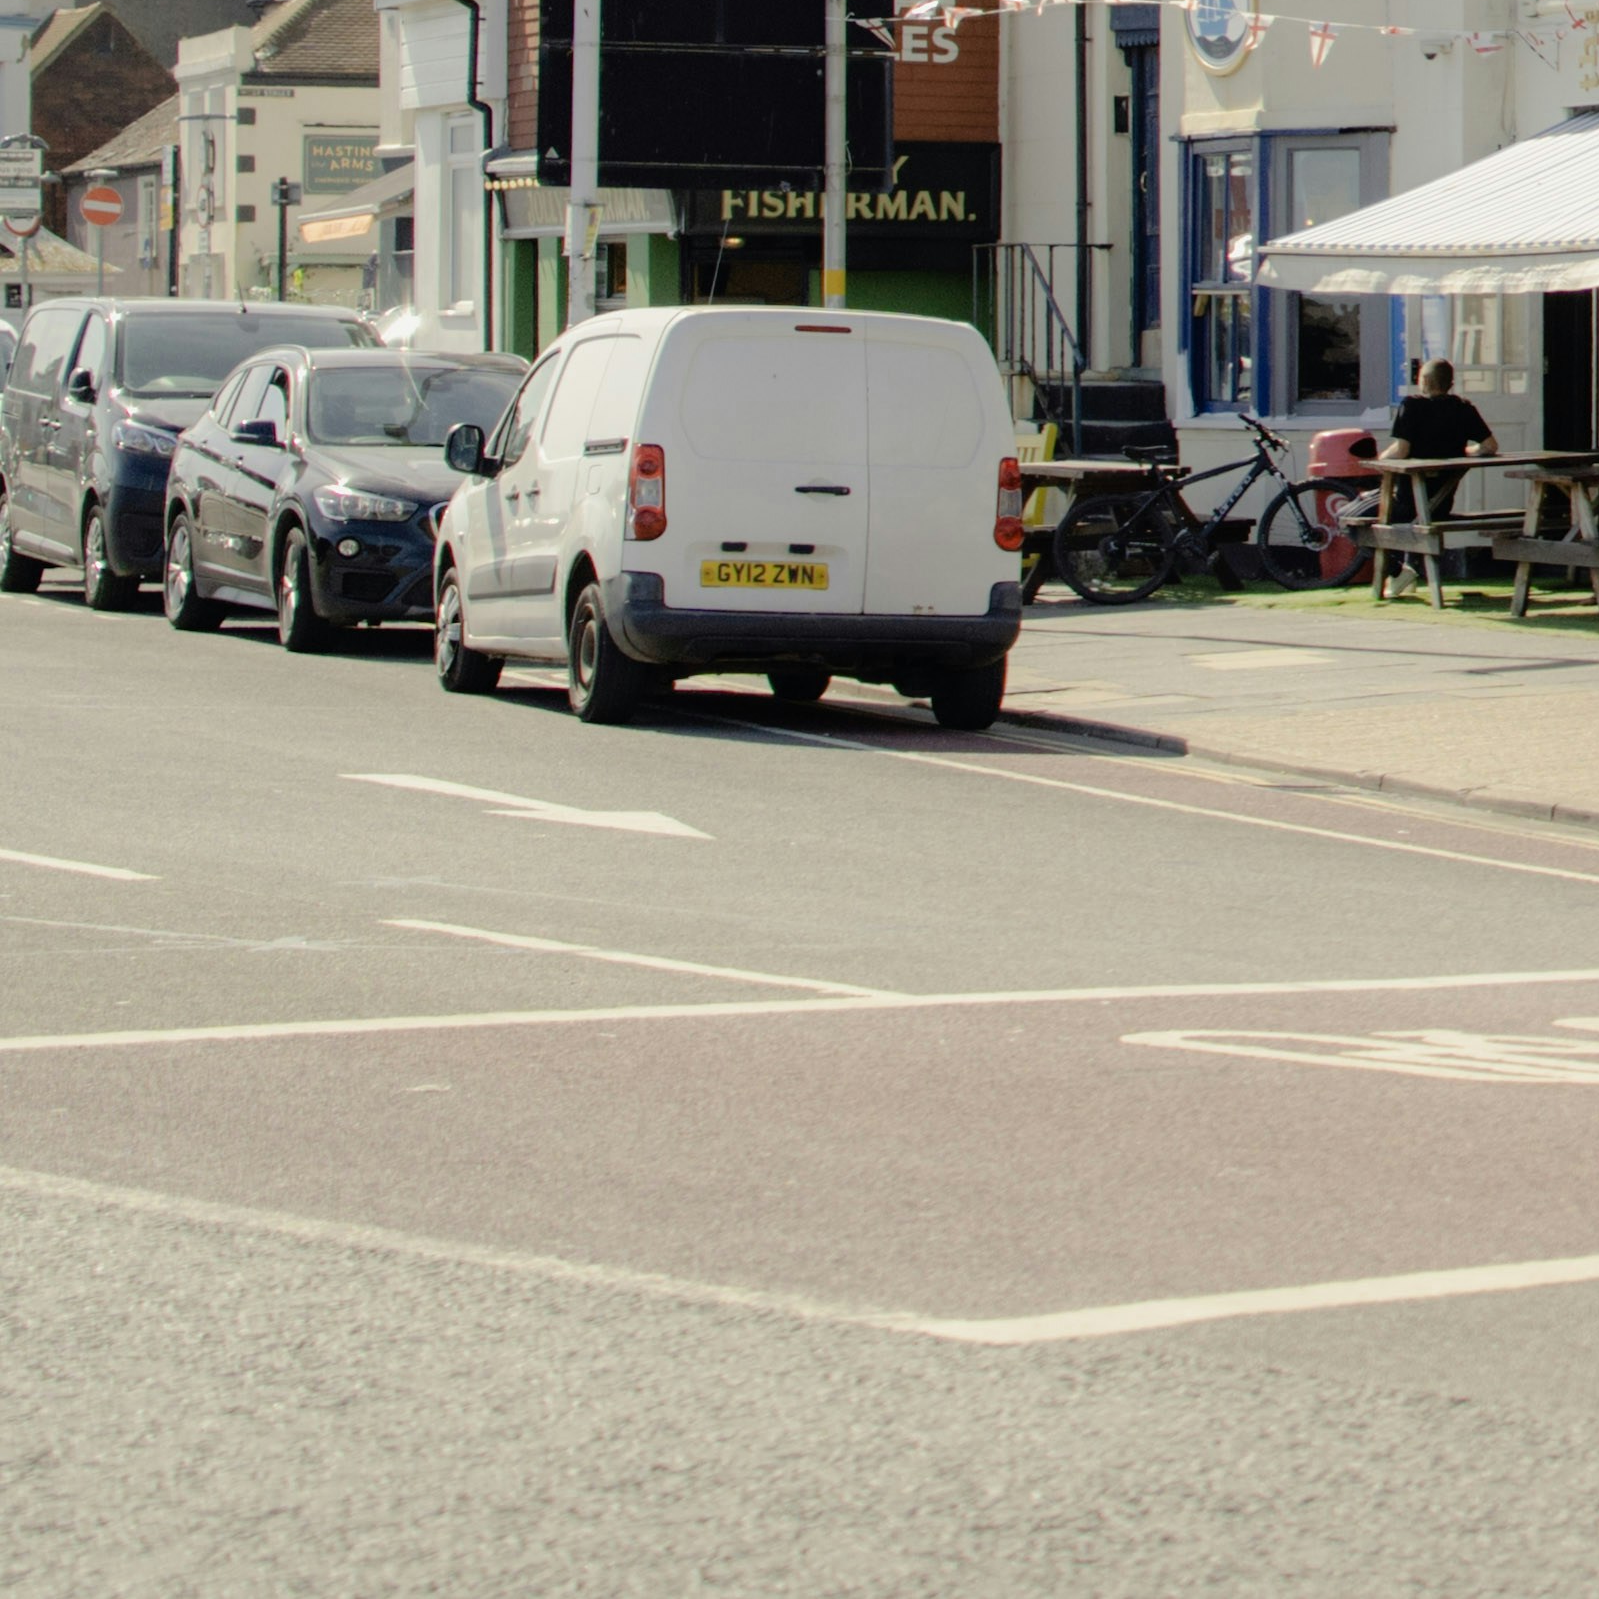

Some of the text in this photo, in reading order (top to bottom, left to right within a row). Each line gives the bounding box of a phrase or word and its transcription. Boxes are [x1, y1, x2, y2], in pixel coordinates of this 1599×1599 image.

[330, 157, 375, 171] ARMS
[721, 190, 977, 222] FISHRMAN.
[717, 562, 815, 585] GY12 ZWN
